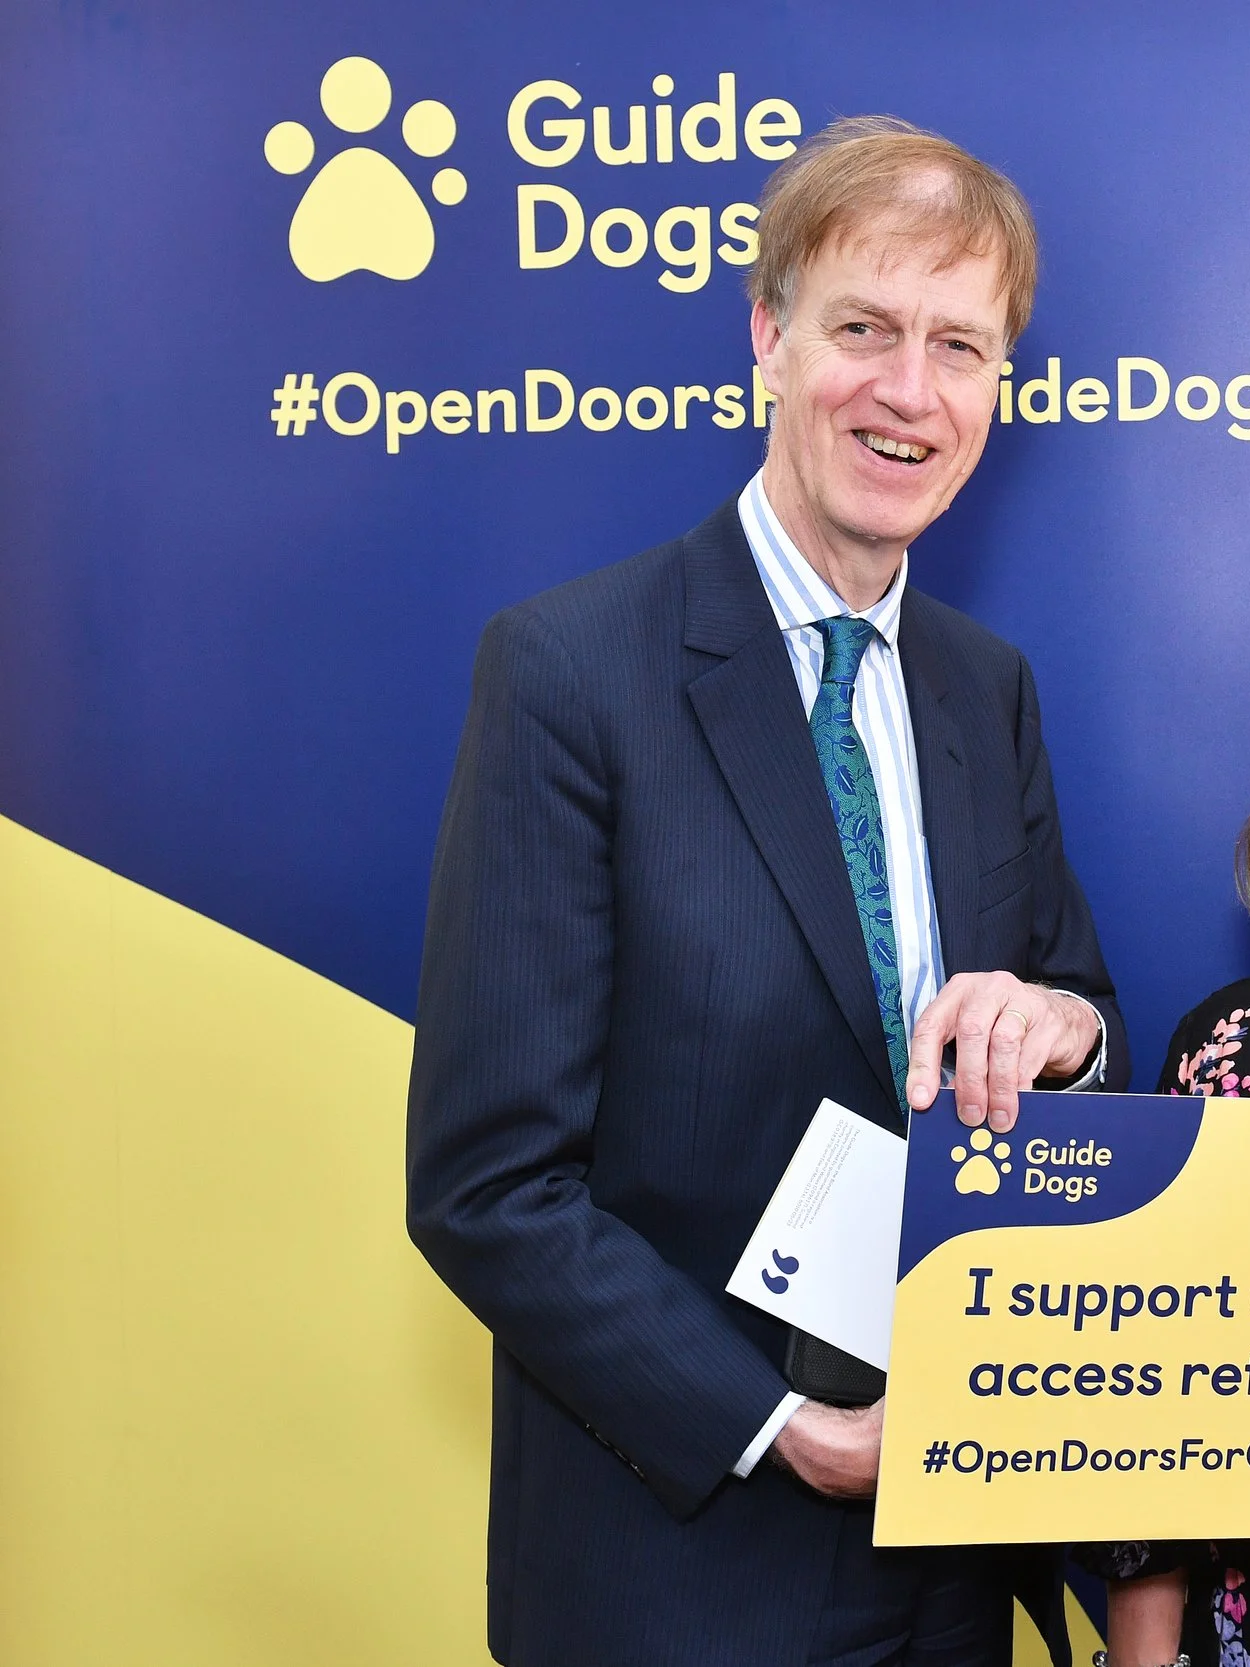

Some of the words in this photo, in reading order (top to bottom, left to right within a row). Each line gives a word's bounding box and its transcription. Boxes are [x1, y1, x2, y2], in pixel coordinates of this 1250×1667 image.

[506, 72, 802, 168] Guide
[516, 183, 761, 294] Dogs
[1024, 1138, 1113, 1167] Guide
[1023, 1167, 1099, 1203] Dogs
[964, 1267, 994, 1316] I
[1008, 1275, 1238, 1332] support
[968, 1361, 1163, 1397] access
